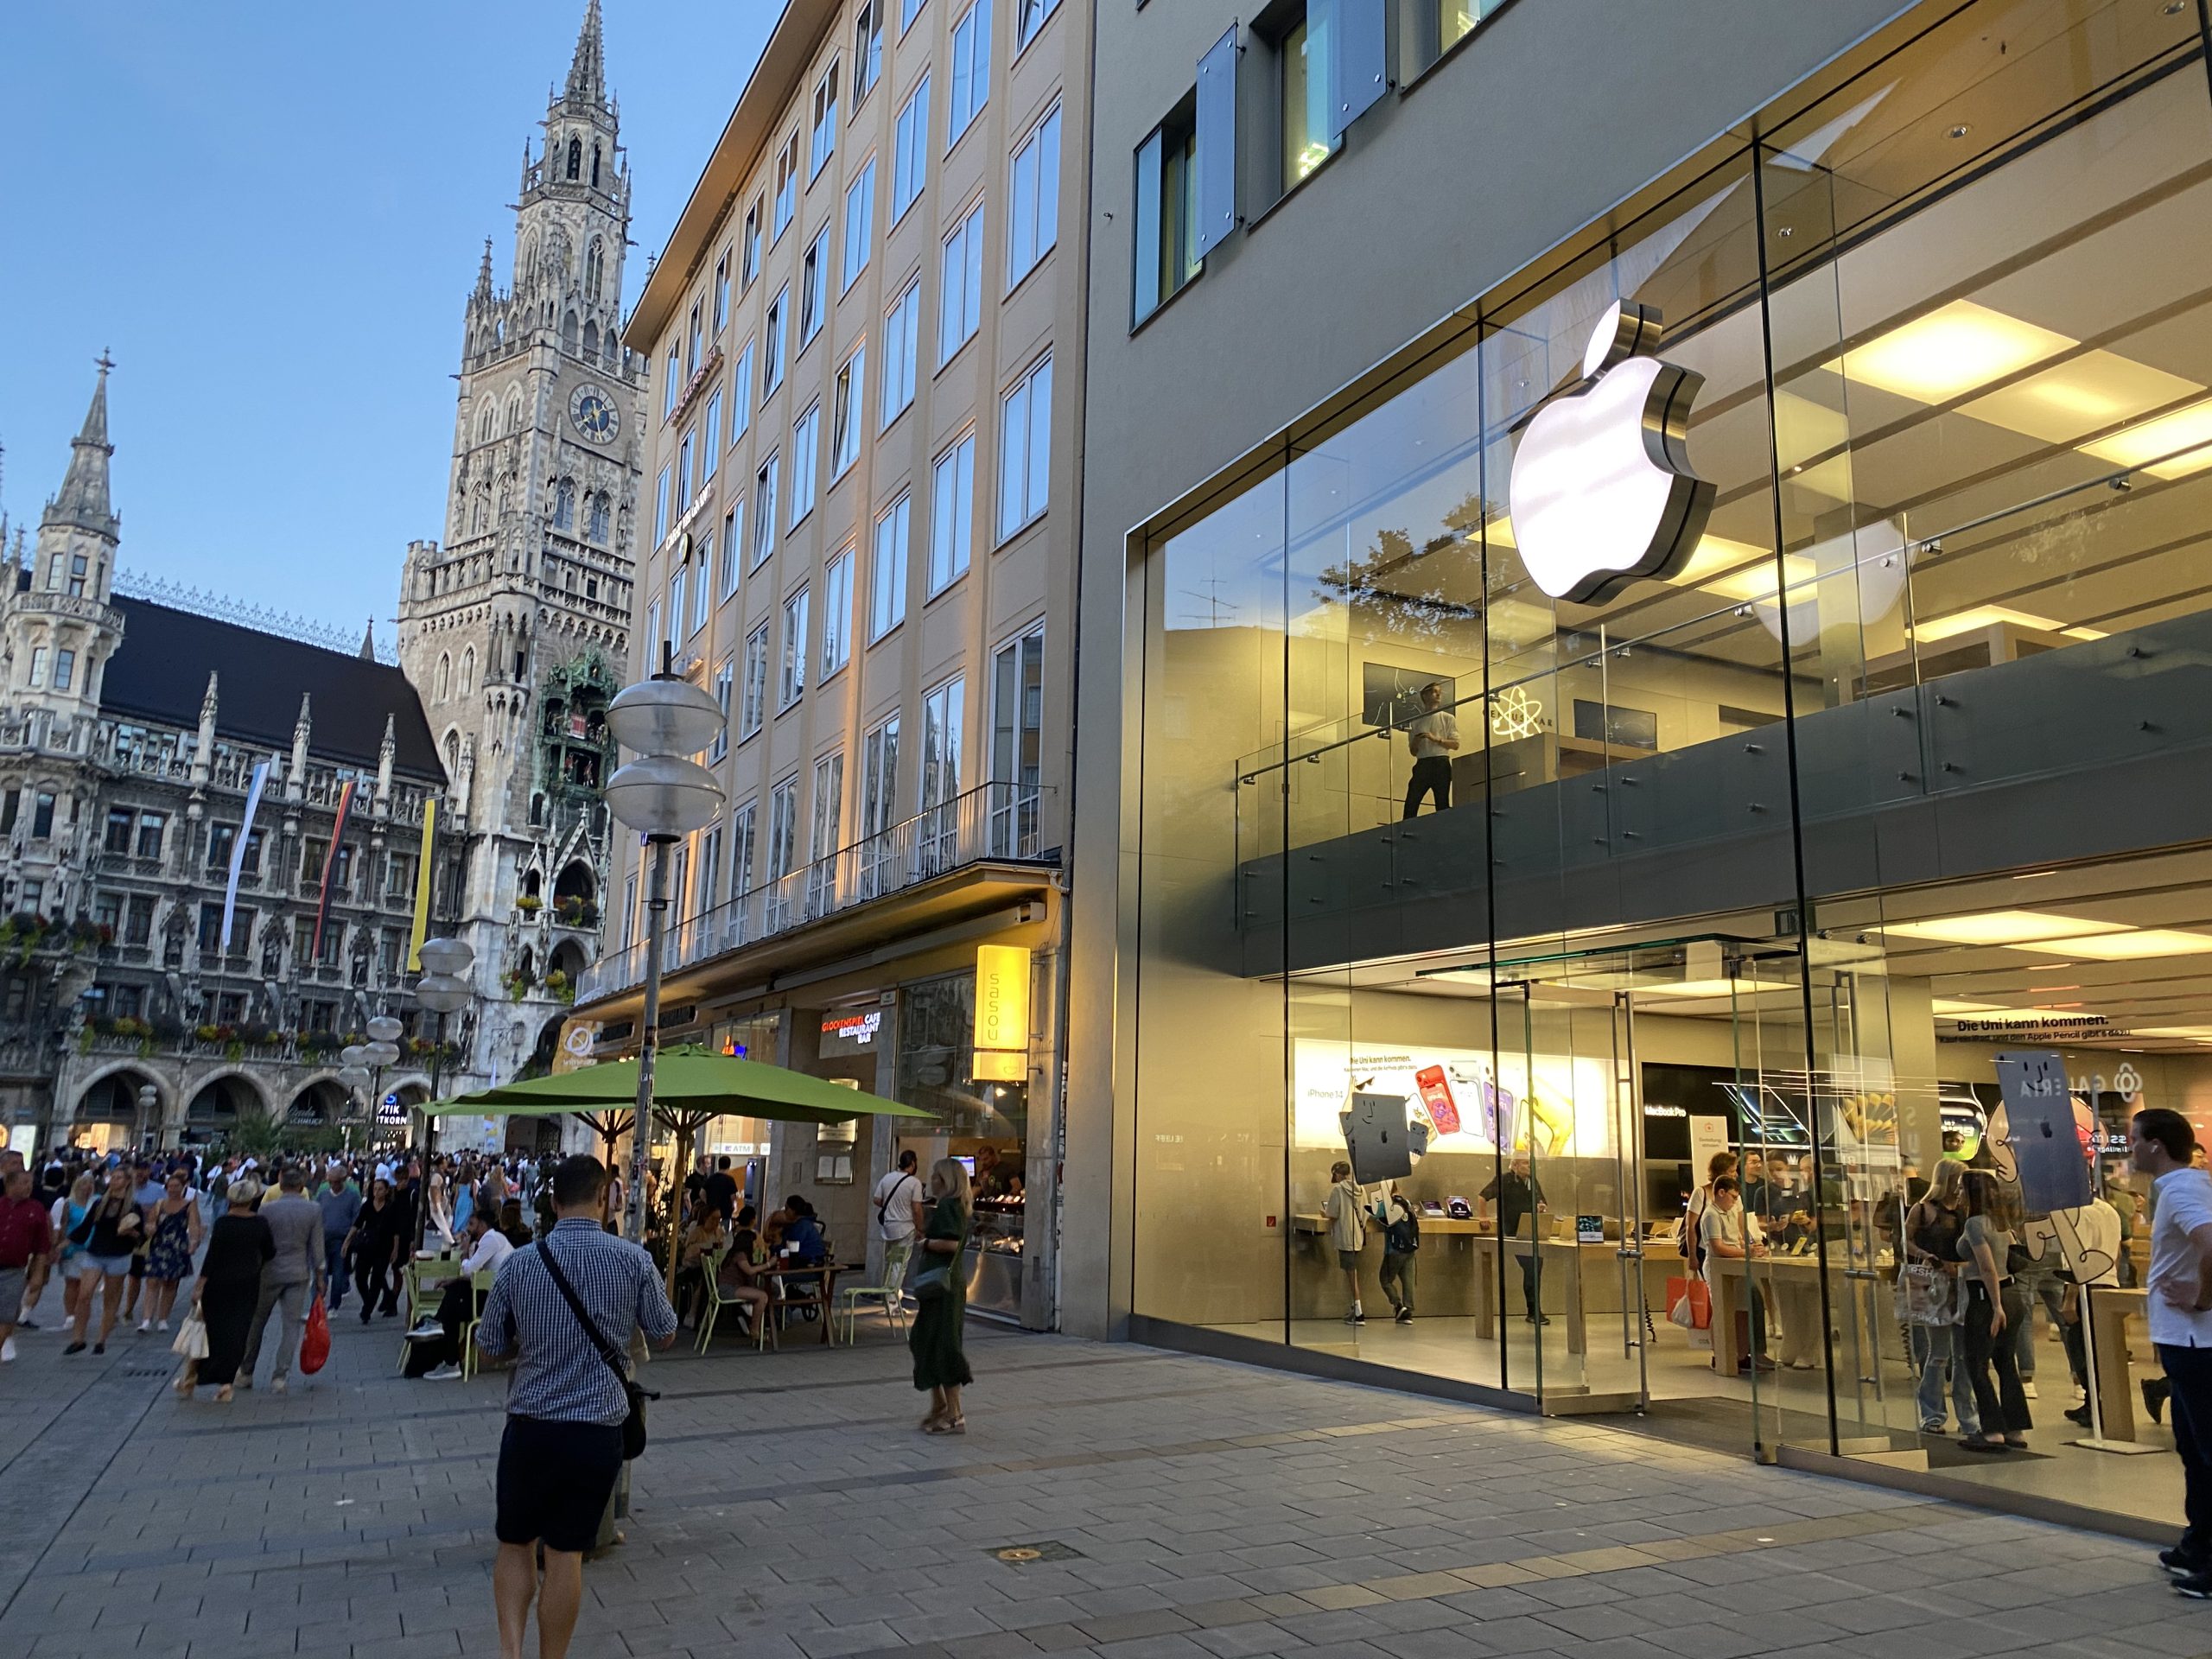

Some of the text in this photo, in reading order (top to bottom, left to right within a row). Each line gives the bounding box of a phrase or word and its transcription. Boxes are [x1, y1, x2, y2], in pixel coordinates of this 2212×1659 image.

[988, 973, 1000, 1041] sasou
[822, 1014, 864, 1033] GLOCKENSPIEL
[1957, 1015, 2109, 1032] Die Uni kann kommen.
[838, 1022, 880, 1039] RESTAURANT
[2027, 1033, 2052, 1041] Apple
[2053, 1030, 2080, 1039] Pencil
[857, 1033, 872, 1045] BAR
[1359, 1056, 1369, 1065] Uni
[1369, 1055, 1383, 1064] kann
[1383, 1054, 1412, 1063] kommen.
[1307, 1089, 1334, 1099] iPhone
[378, 1104, 400, 1115] PTIK
[1644, 1105, 1687, 1118] MacBook Pro
[376, 1115, 408, 1125] TKORN
